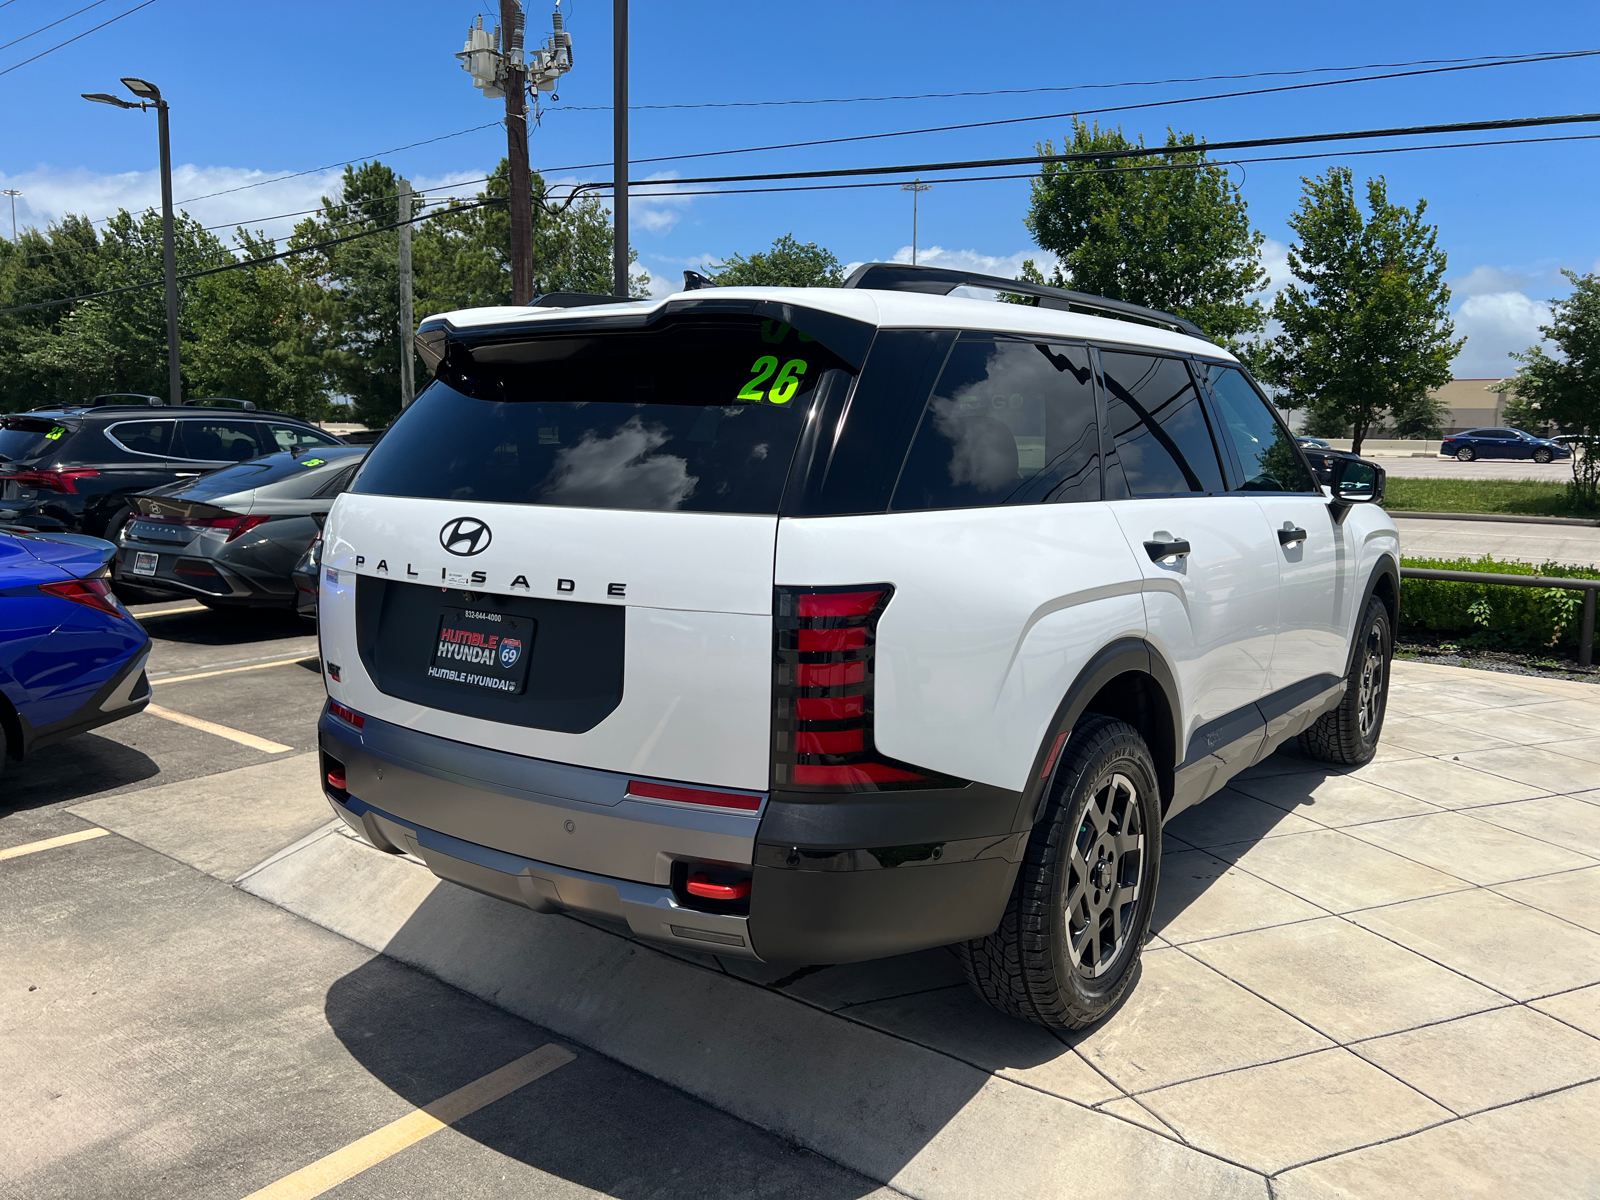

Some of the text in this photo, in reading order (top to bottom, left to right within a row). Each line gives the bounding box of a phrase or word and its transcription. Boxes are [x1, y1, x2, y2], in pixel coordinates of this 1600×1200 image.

[737, 355, 808, 404] 26
[45, 426, 66, 440] 23
[355, 555, 627, 596] PALISADE
[465, 610, 502, 622] 832-644-4000
[441, 628, 499, 649] HUMBLE
[437, 641, 496, 666] HYUNDAI
[501, 648, 517, 663] 69
[428, 666, 467, 682] HUMBLE
[466, 673, 509, 691] HYUNDAI
